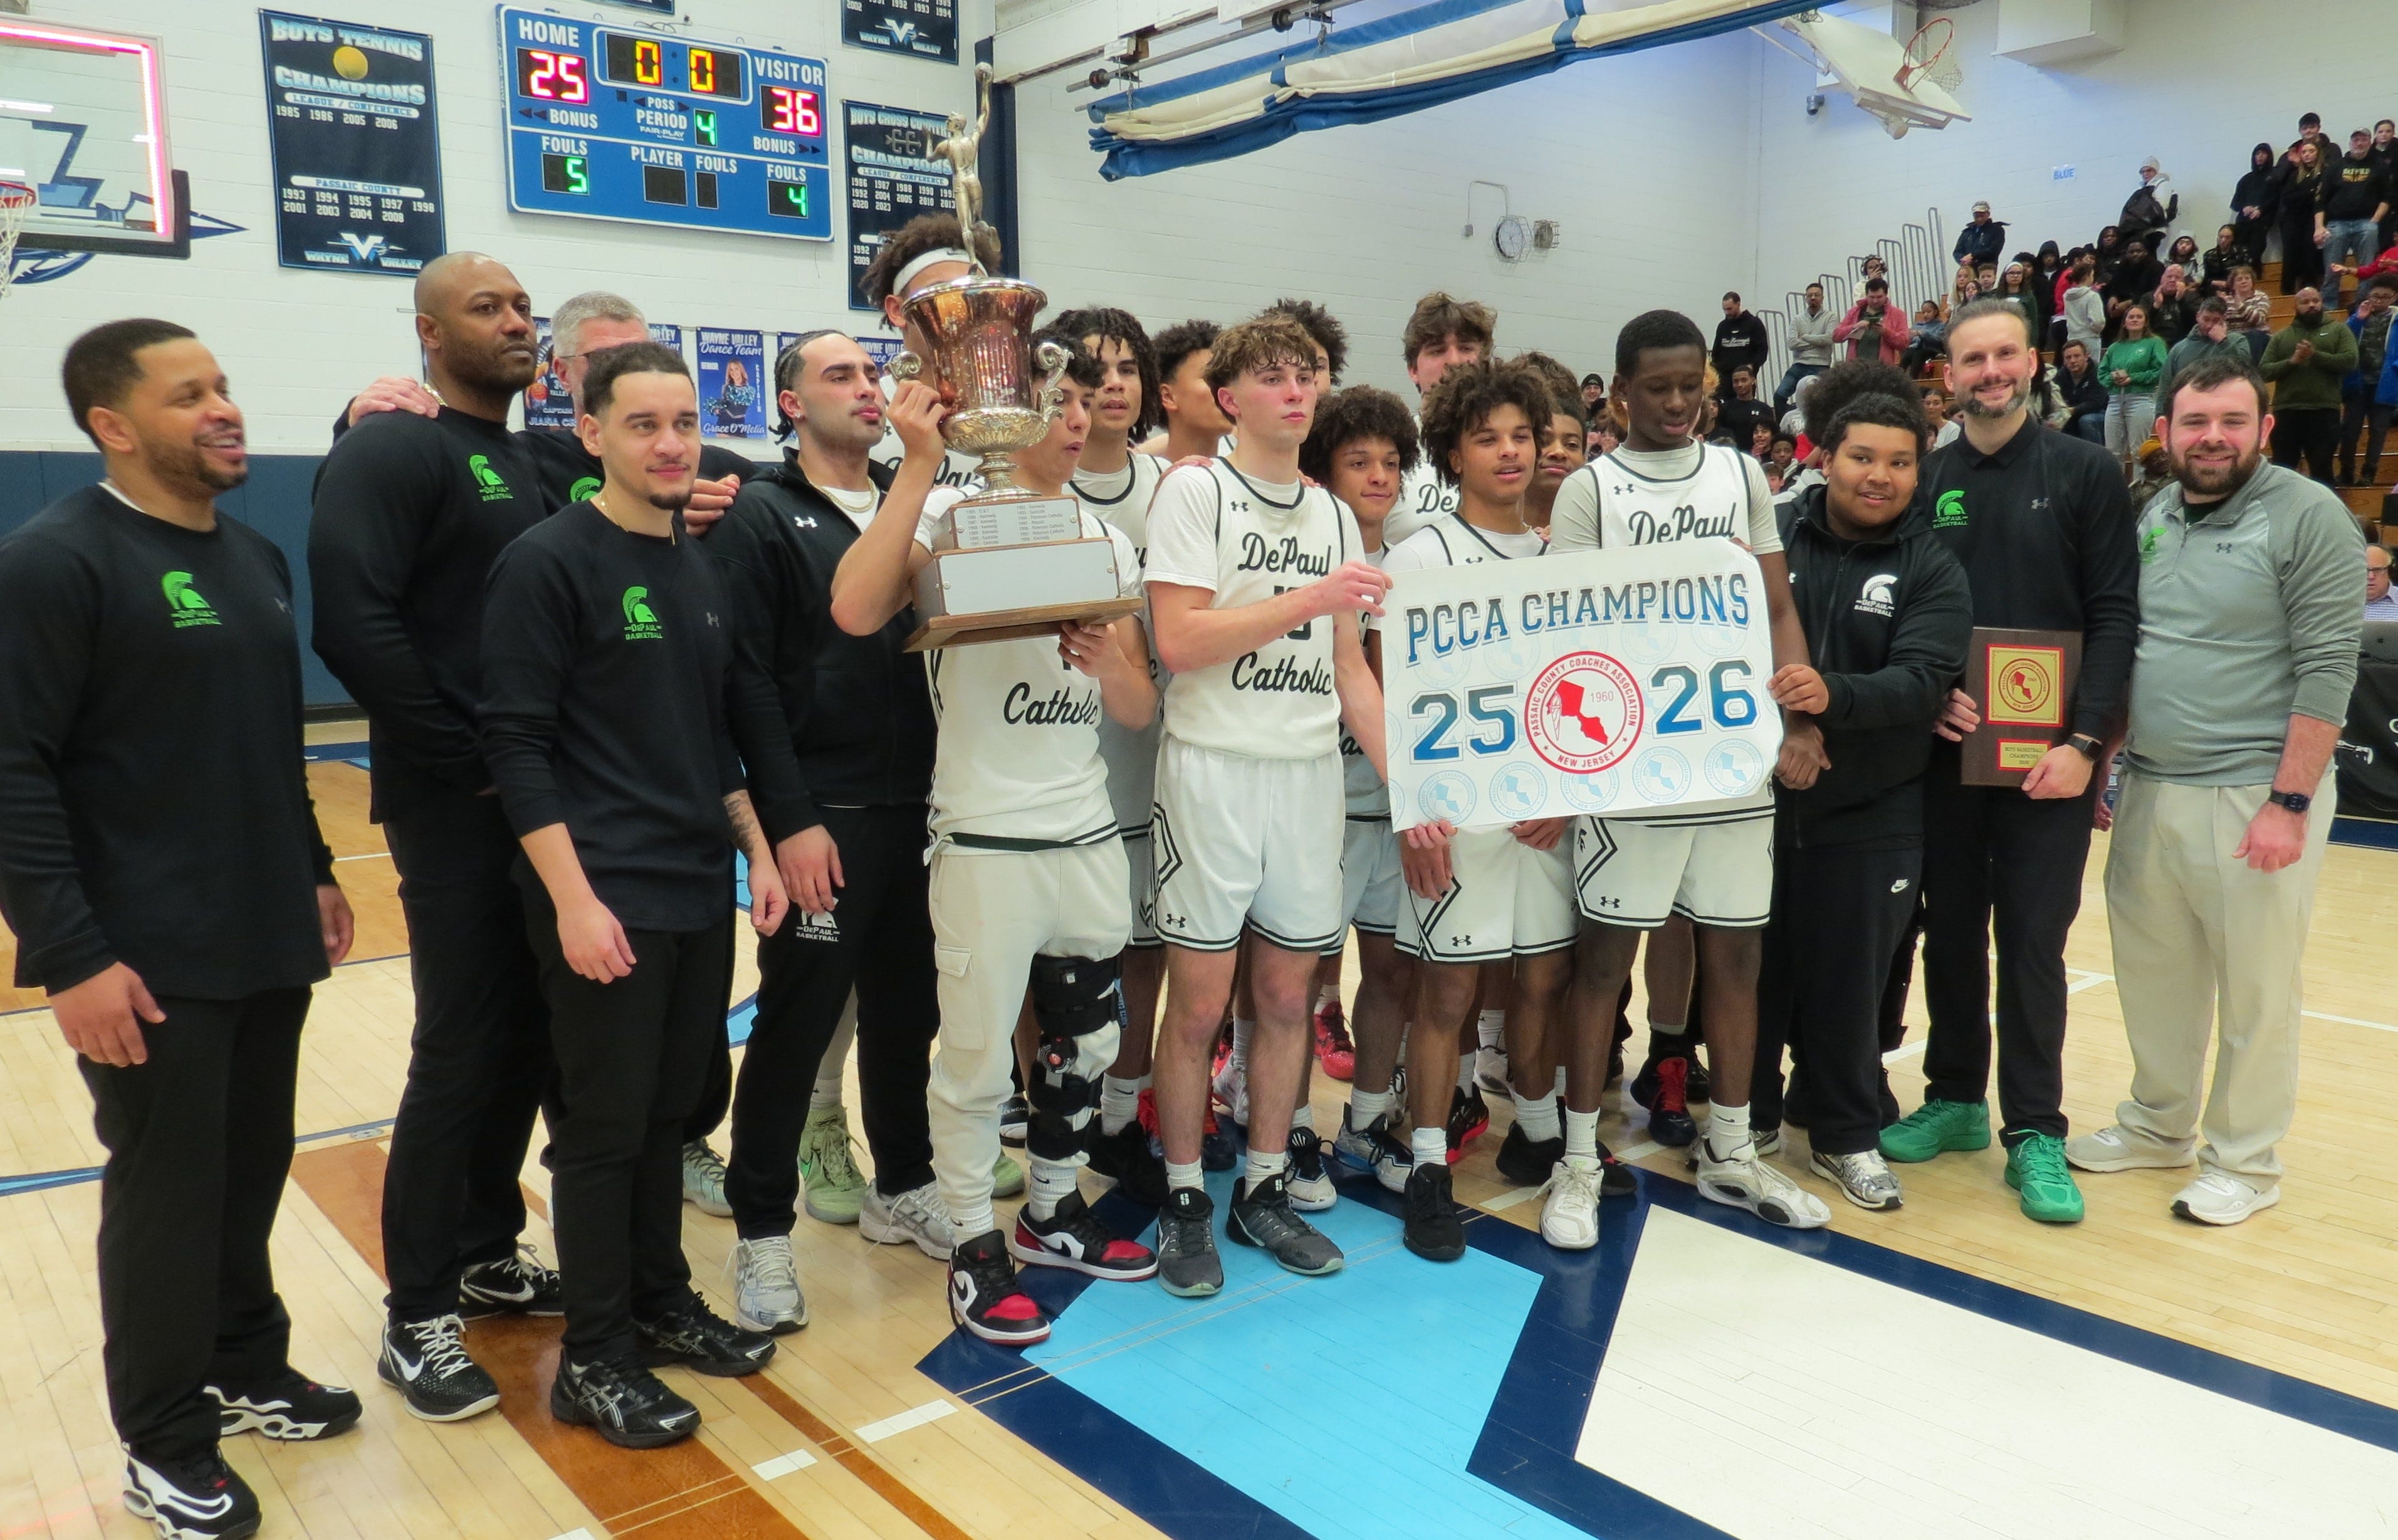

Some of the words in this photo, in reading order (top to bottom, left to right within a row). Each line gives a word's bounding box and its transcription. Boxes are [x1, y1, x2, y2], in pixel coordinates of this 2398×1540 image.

[914, 3, 929, 14] 1993
[936, 7, 951, 18] 1994
[271, 18, 334, 43] BOYS
[338, 28, 424, 62] TENNIS
[518, 19, 579, 48] HOME
[859, 31, 890, 46] WAYNE
[911, 41, 941, 55] VALLEY
[529, 51, 586, 102] 25
[634, 41, 660, 85] 0
[689, 49, 713, 93] 0
[754, 56, 824, 86] VISITOR
[275, 65, 426, 105] CHAMPIONS
[293, 94, 334, 107] LEAGUE
[348, 101, 413, 117] CONFERENCE
[647, 97, 675, 112] POSS
[770, 87, 818, 134] 36
[276, 105, 300, 118] 1985
[310, 109, 333, 122] 1986
[343, 113, 366, 126] 2005
[375, 117, 398, 130] 2006
[550, 108, 598, 129] BONUS
[636, 109, 688, 130] PERIOD
[850, 107, 876, 125] BOYS
[877, 111, 909, 128] CROSS
[696, 113, 716, 146] 4
[542, 135, 588, 156] FOULS
[753, 135, 795, 155] BONUS
[631, 147, 683, 167] PLAYER
[696, 155, 738, 174] FOULS
[852, 144, 953, 175] CHAMPIONS
[566, 157, 588, 194] 5
[767, 163, 807, 182] FOULS
[862, 168, 892, 177] LEAGUE
[315, 179, 358, 191] PASSAIC
[362, 184, 402, 196] COUNTY
[875, 180, 890, 190] 1987
[283, 188, 306, 200] 1993
[315, 191, 339, 204] 1994
[348, 194, 372, 207] 1995
[381, 197, 403, 210] 1997
[412, 201, 435, 213] 1998
[788, 185, 807, 217] 4
[852, 188, 868, 198] 1992
[875, 191, 891, 201] 2004
[919, 196, 934, 207] 2010
[940, 199, 955, 209] 2013
[852, 199, 869, 209] 2020
[875, 201, 891, 212] 2023
[283, 201, 307, 214] 2001
[316, 204, 340, 217] 2003
[350, 207, 372, 220] 2004
[853, 244, 870, 255] 1992
[304, 251, 350, 265] WAYNE
[379, 256, 423, 270] VALLEY
[699, 342, 733, 355] Dance
[735, 344, 762, 356] Team
[701, 332, 730, 345] WAYNE
[731, 333, 758, 347] VALLEY
[885, 343, 904, 354] VALLE
[871, 354, 886, 363] nce
[703, 423, 730, 434] Grace
[1628, 502, 1737, 547] DePaul
[1238, 532, 1331, 577] DePaul
[1406, 597, 1511, 665] PCCA
[1521, 572, 1749, 633] CHAMPIONS
[1232, 651, 1333, 696] Catholic
[1531, 697, 1542, 737] PASSAIC
[1537, 663, 1566, 694] COUNTY
[1569, 657, 1611, 671] COACHES
[1611, 668, 1638, 726] ASSOCIATION
[1589, 691, 1614, 703] 1960
[1408, 683, 1519, 764] 25
[1648, 657, 1759, 738] 26
[1558, 755, 1578, 767] NEW
[1581, 749, 1615, 768] JERSEY
[796, 931, 839, 942] BASKETBALL
